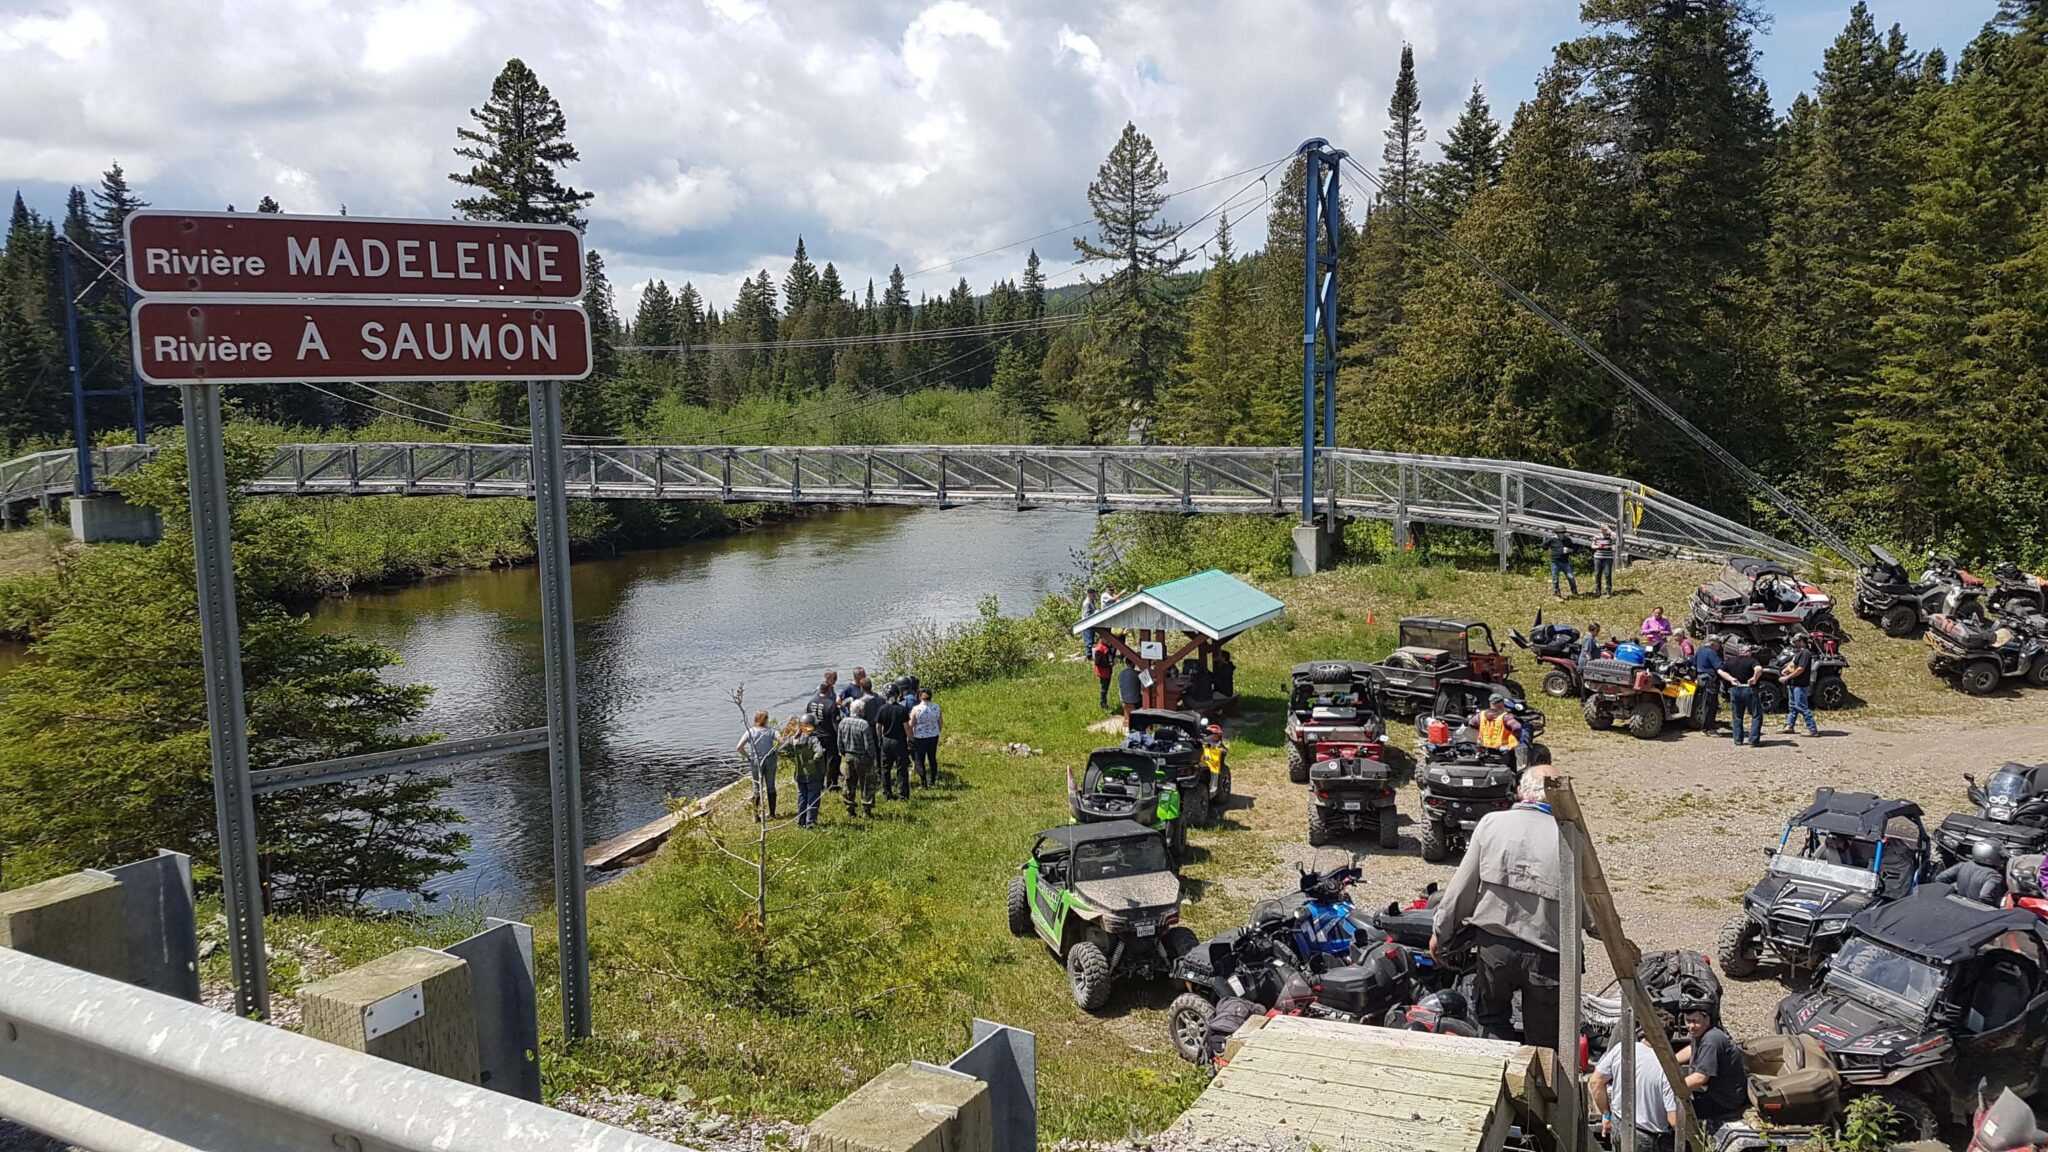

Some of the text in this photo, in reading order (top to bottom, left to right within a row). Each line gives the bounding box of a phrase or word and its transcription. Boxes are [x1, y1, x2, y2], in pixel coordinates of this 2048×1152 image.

[146, 235, 563, 283] Rivière MADELEINE
[154, 315, 558, 362] Rivière À SAUMON
